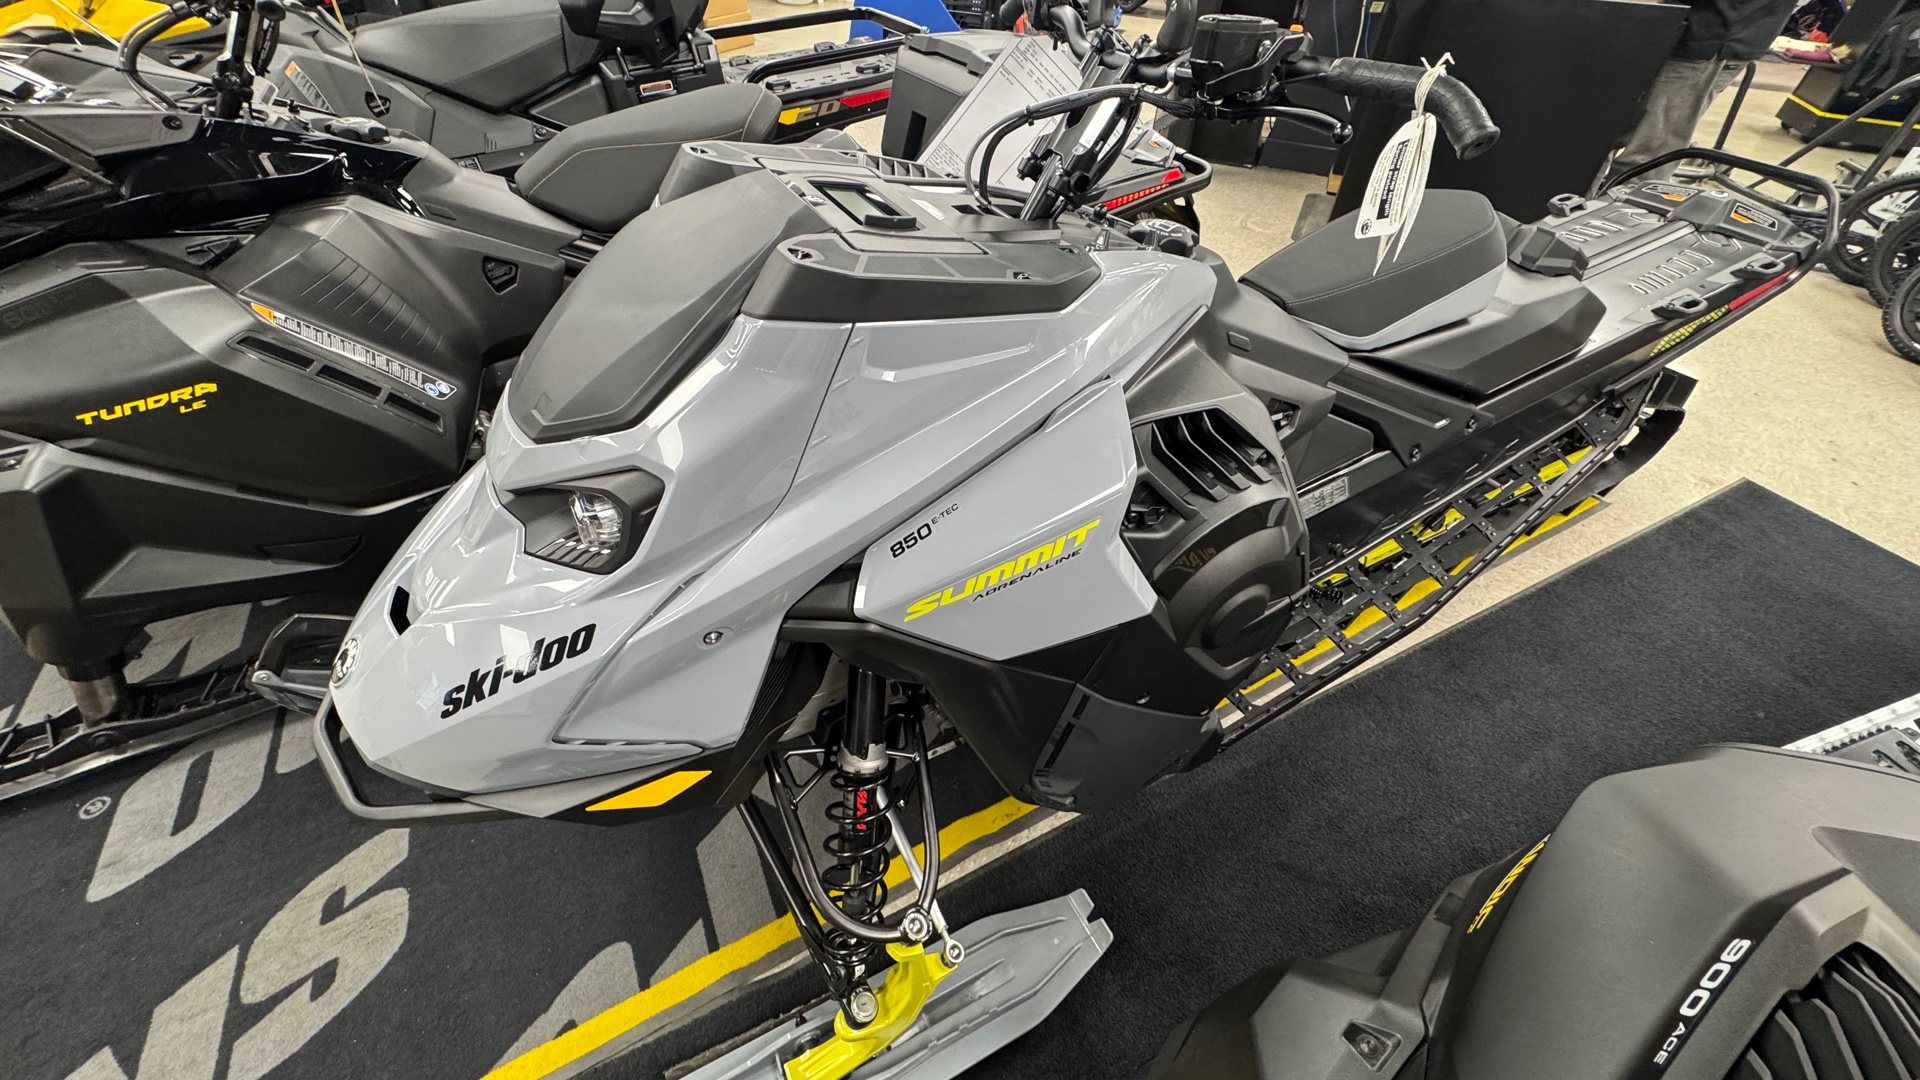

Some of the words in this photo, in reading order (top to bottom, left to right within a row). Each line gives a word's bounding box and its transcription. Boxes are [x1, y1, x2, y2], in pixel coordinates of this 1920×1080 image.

[75, 382, 218, 425] TUNDRA
[179, 400, 207, 414] LE
[889, 522, 933, 559] 850
[931, 502, 960, 525] E-TEC
[903, 518, 1101, 623] SUMMIT
[971, 547, 1083, 602] ADRENALINE
[440, 622, 597, 720] ski-doo
[1679, 938, 1752, 1017] 900
[1653, 1021, 1686, 1066] ACE
